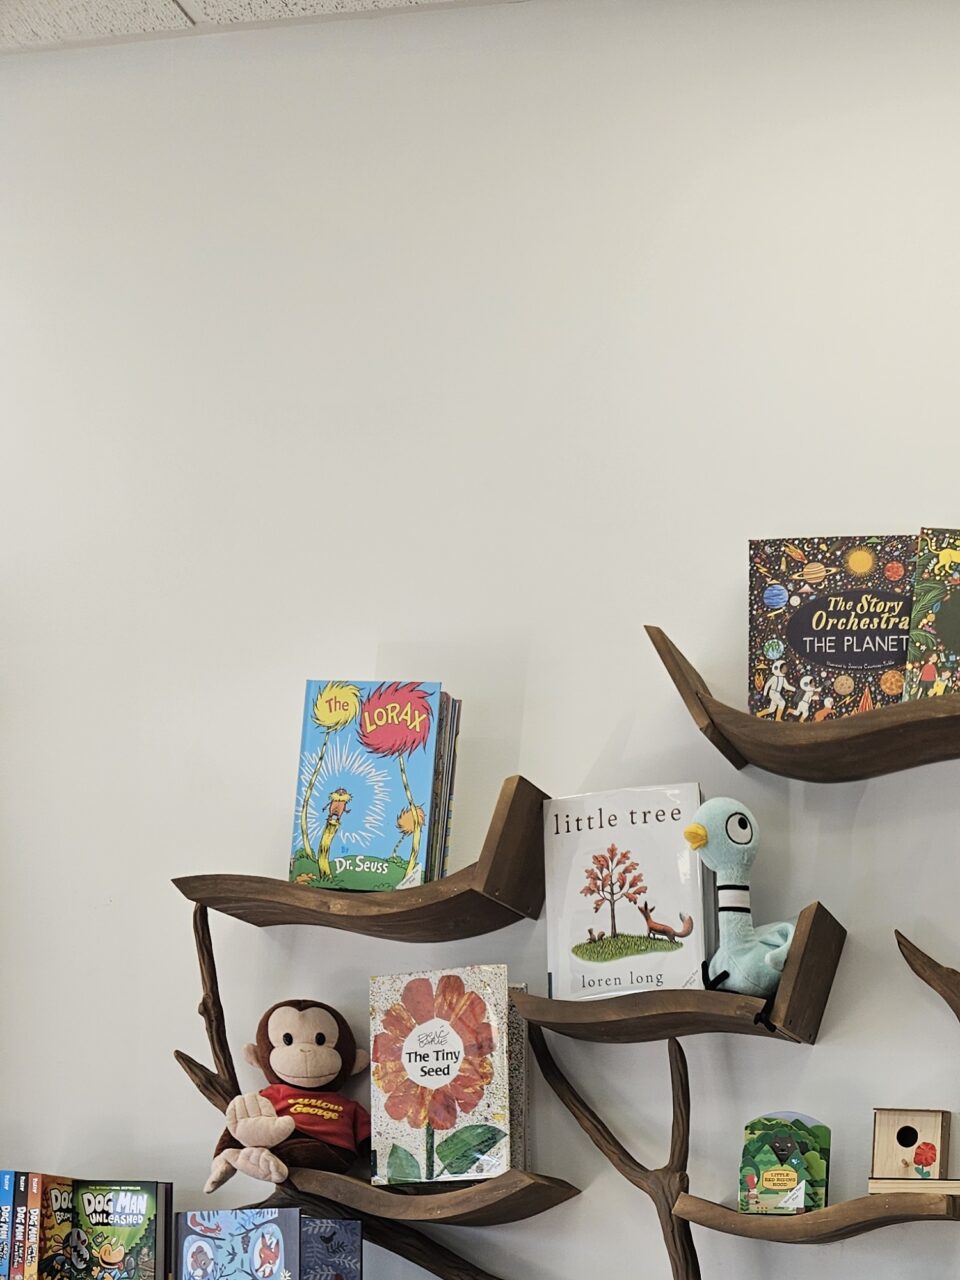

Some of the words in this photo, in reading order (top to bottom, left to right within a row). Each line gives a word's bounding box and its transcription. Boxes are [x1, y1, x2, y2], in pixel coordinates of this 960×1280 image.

[828, 597, 853, 611] The
[856, 594, 903, 615] Story
[812, 611, 910, 630] Orchestra
[803, 637, 836, 652] THE
[325, 696, 349, 713] The
[364, 702, 428, 733] LORAX
[554, 807, 618, 834] little
[630, 807, 682, 824] tree
[335, 858, 353, 873] Dr.
[355, 856, 388, 873] Seuss
[582, 974, 622, 988] loren
[630, 972, 664, 986] long
[406, 1050, 429, 1063] The
[432, 1049, 460, 1063] Tiny
[420, 1064, 450, 1077] Seed
[289, 1105, 340, 1121] George
[82, 1192, 113, 1214] DOG
[116, 1192, 148, 1214] MAN
[0, 1205, 9, 1221] DOG
[16, 1206, 25, 1222] DOG
[29, 1208, 38, 1224] DOG
[0, 1223, 8, 1238] MAN
[14, 1224, 24, 1240] MAN
[27, 1226, 37, 1241] MAN
